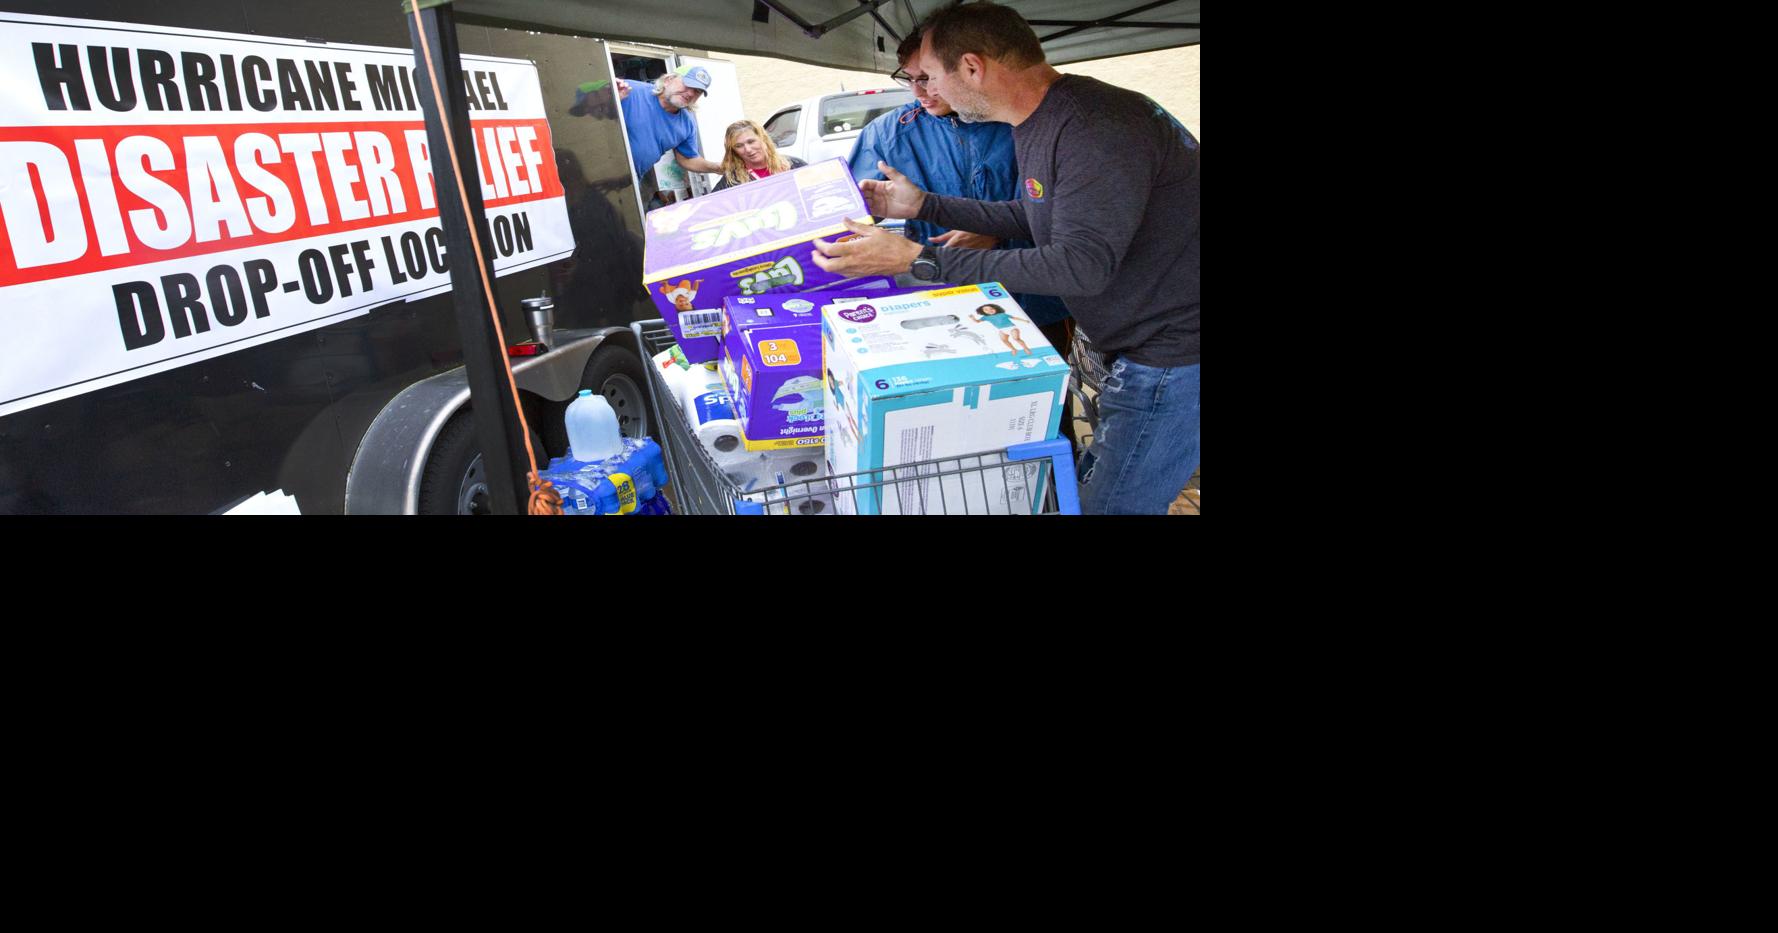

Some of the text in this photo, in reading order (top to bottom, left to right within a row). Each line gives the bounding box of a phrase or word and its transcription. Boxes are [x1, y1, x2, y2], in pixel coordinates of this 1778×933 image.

[31, 42, 508, 113] HURRICANE MIAEL
[0, 126, 542, 270] DISASTER RLIEF
[112, 240, 376, 351] DROP-OFF
[988, 289, 1002, 297] 6
[769, 342, 778, 350] 3
[765, 354, 786, 364] 104
[875, 379, 889, 390] 6
[780, 424, 818, 435] Overnight
